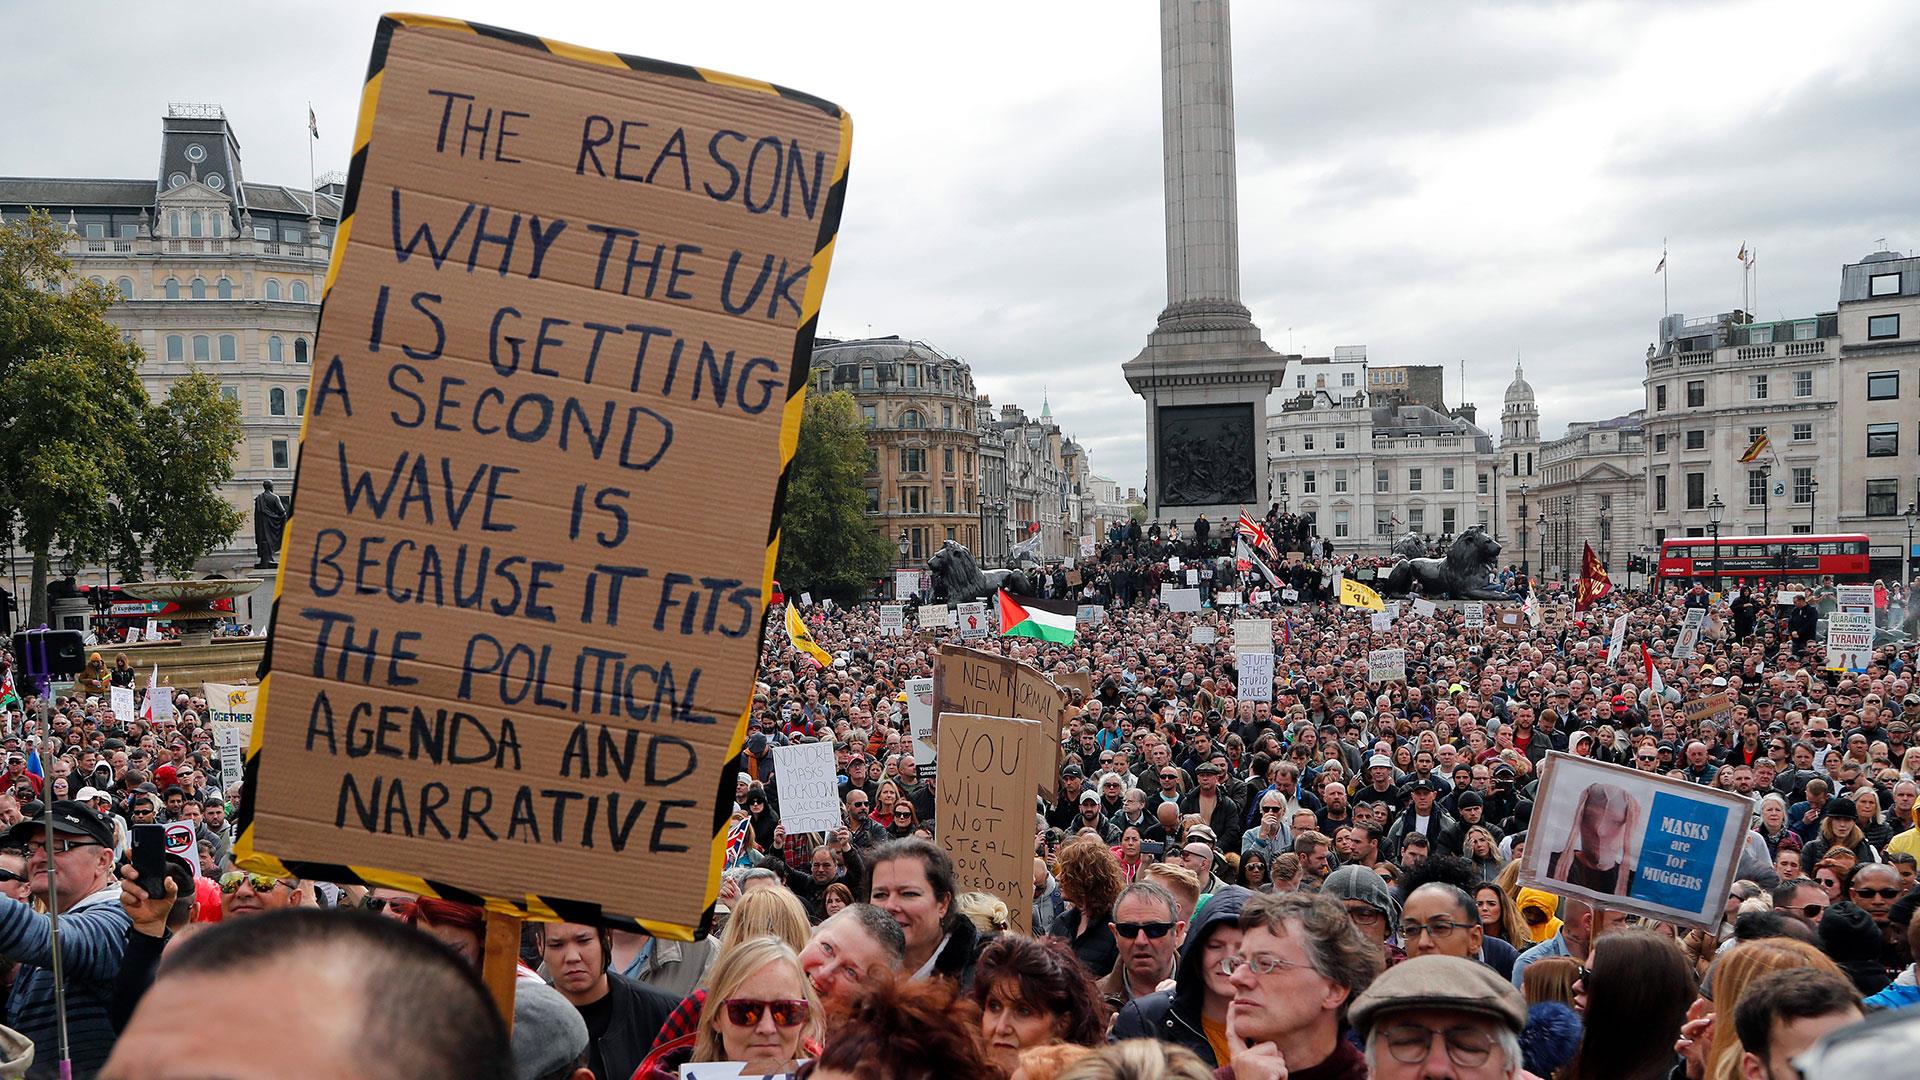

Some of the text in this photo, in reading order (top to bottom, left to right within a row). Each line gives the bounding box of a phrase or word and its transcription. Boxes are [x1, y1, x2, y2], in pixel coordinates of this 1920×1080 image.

[428, 88, 826, 221] THE REASON
[391, 187, 815, 320] WHY THE UK
[368, 285, 785, 416] IS GETTING
[313, 354, 675, 473] A SECOND
[338, 442, 632, 549] WAVE IS
[309, 528, 763, 638] BECAUSE IT FITS
[1830, 615, 1872, 624] QUARANTINE
[1830, 634, 1870, 644] TYRANNY
[301, 607, 718, 726] THE POLITICAL
[1242, 654, 1271, 666] STUFF
[1246, 666, 1266, 676] THE
[914, 684, 932, 692] COVID-
[962, 661, 1054, 723] NEW NORMAL
[1240, 676, 1268, 686] STUPID
[1242, 686, 1268, 697] RULES
[210, 708, 252, 723] TOGETHER
[305, 689, 522, 770] AGENDA
[559, 721, 698, 788] AND
[774, 744, 832, 768] NO MORE
[950, 728, 1023, 776] YOU
[786, 766, 824, 783] MASKS
[335, 773, 698, 854] NARRATIVE
[790, 800, 836, 814] VACCINES
[64, 814, 80, 824] Jeep
[952, 811, 1002, 834] NOT
[1660, 816, 1710, 841] MASKS
[944, 835, 1016, 858] STEAL
[1670, 840, 1690, 852] are
[958, 858, 991, 876] OUR
[1666, 854, 1688, 870] for
[952, 872, 1024, 898] EEDOM
[1642, 866, 1703, 892] MUGGERS
